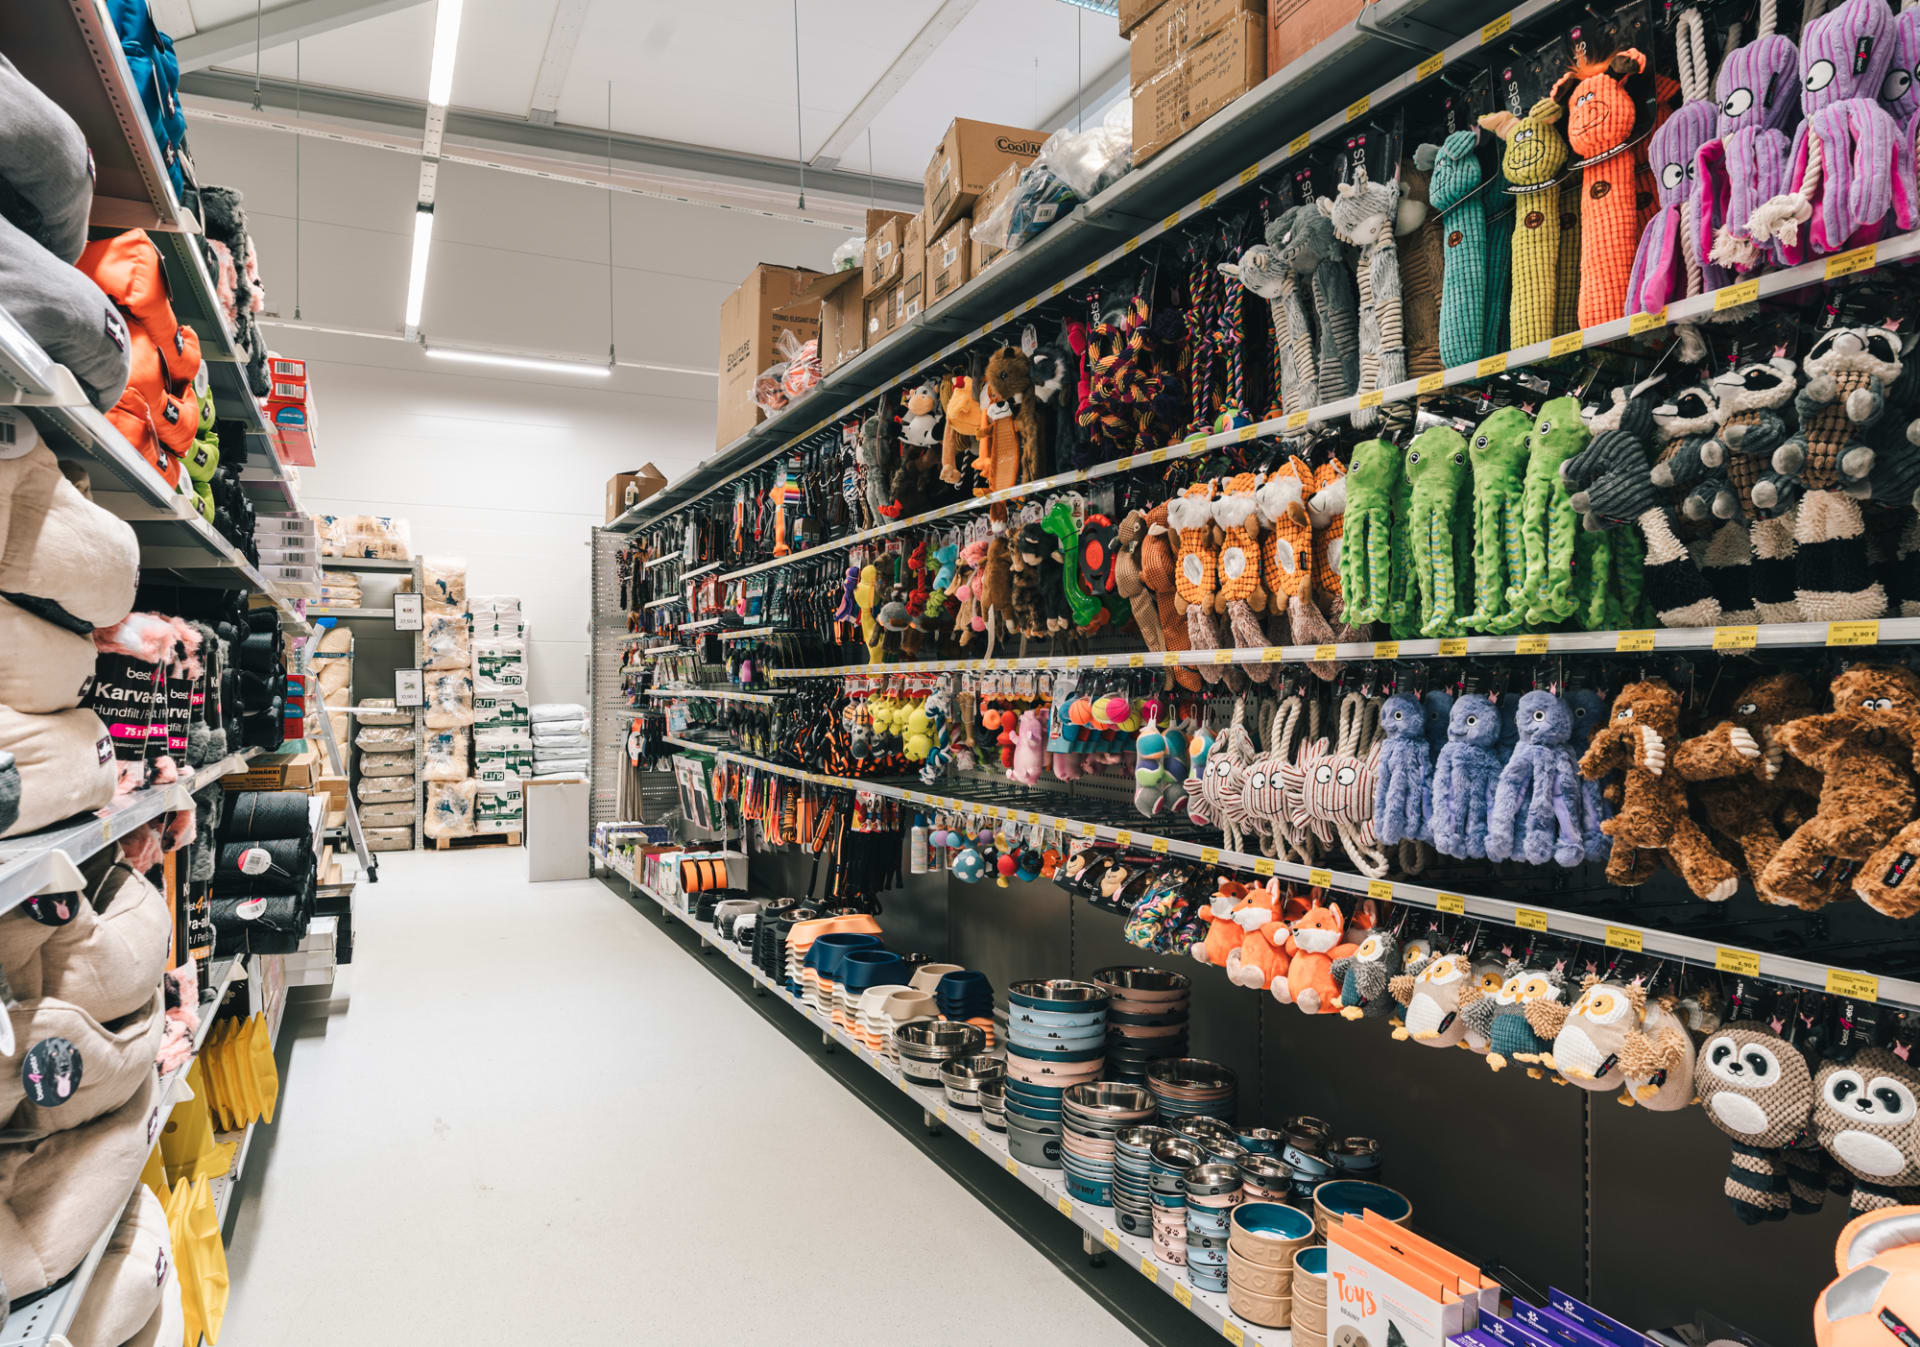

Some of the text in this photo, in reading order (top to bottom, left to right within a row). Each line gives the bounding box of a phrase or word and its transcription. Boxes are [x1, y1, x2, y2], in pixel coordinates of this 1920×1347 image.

[997, 138, 1027, 153] Cool
[475, 698, 496, 708] RUTI
[1332, 1271, 1377, 1318] Toys
